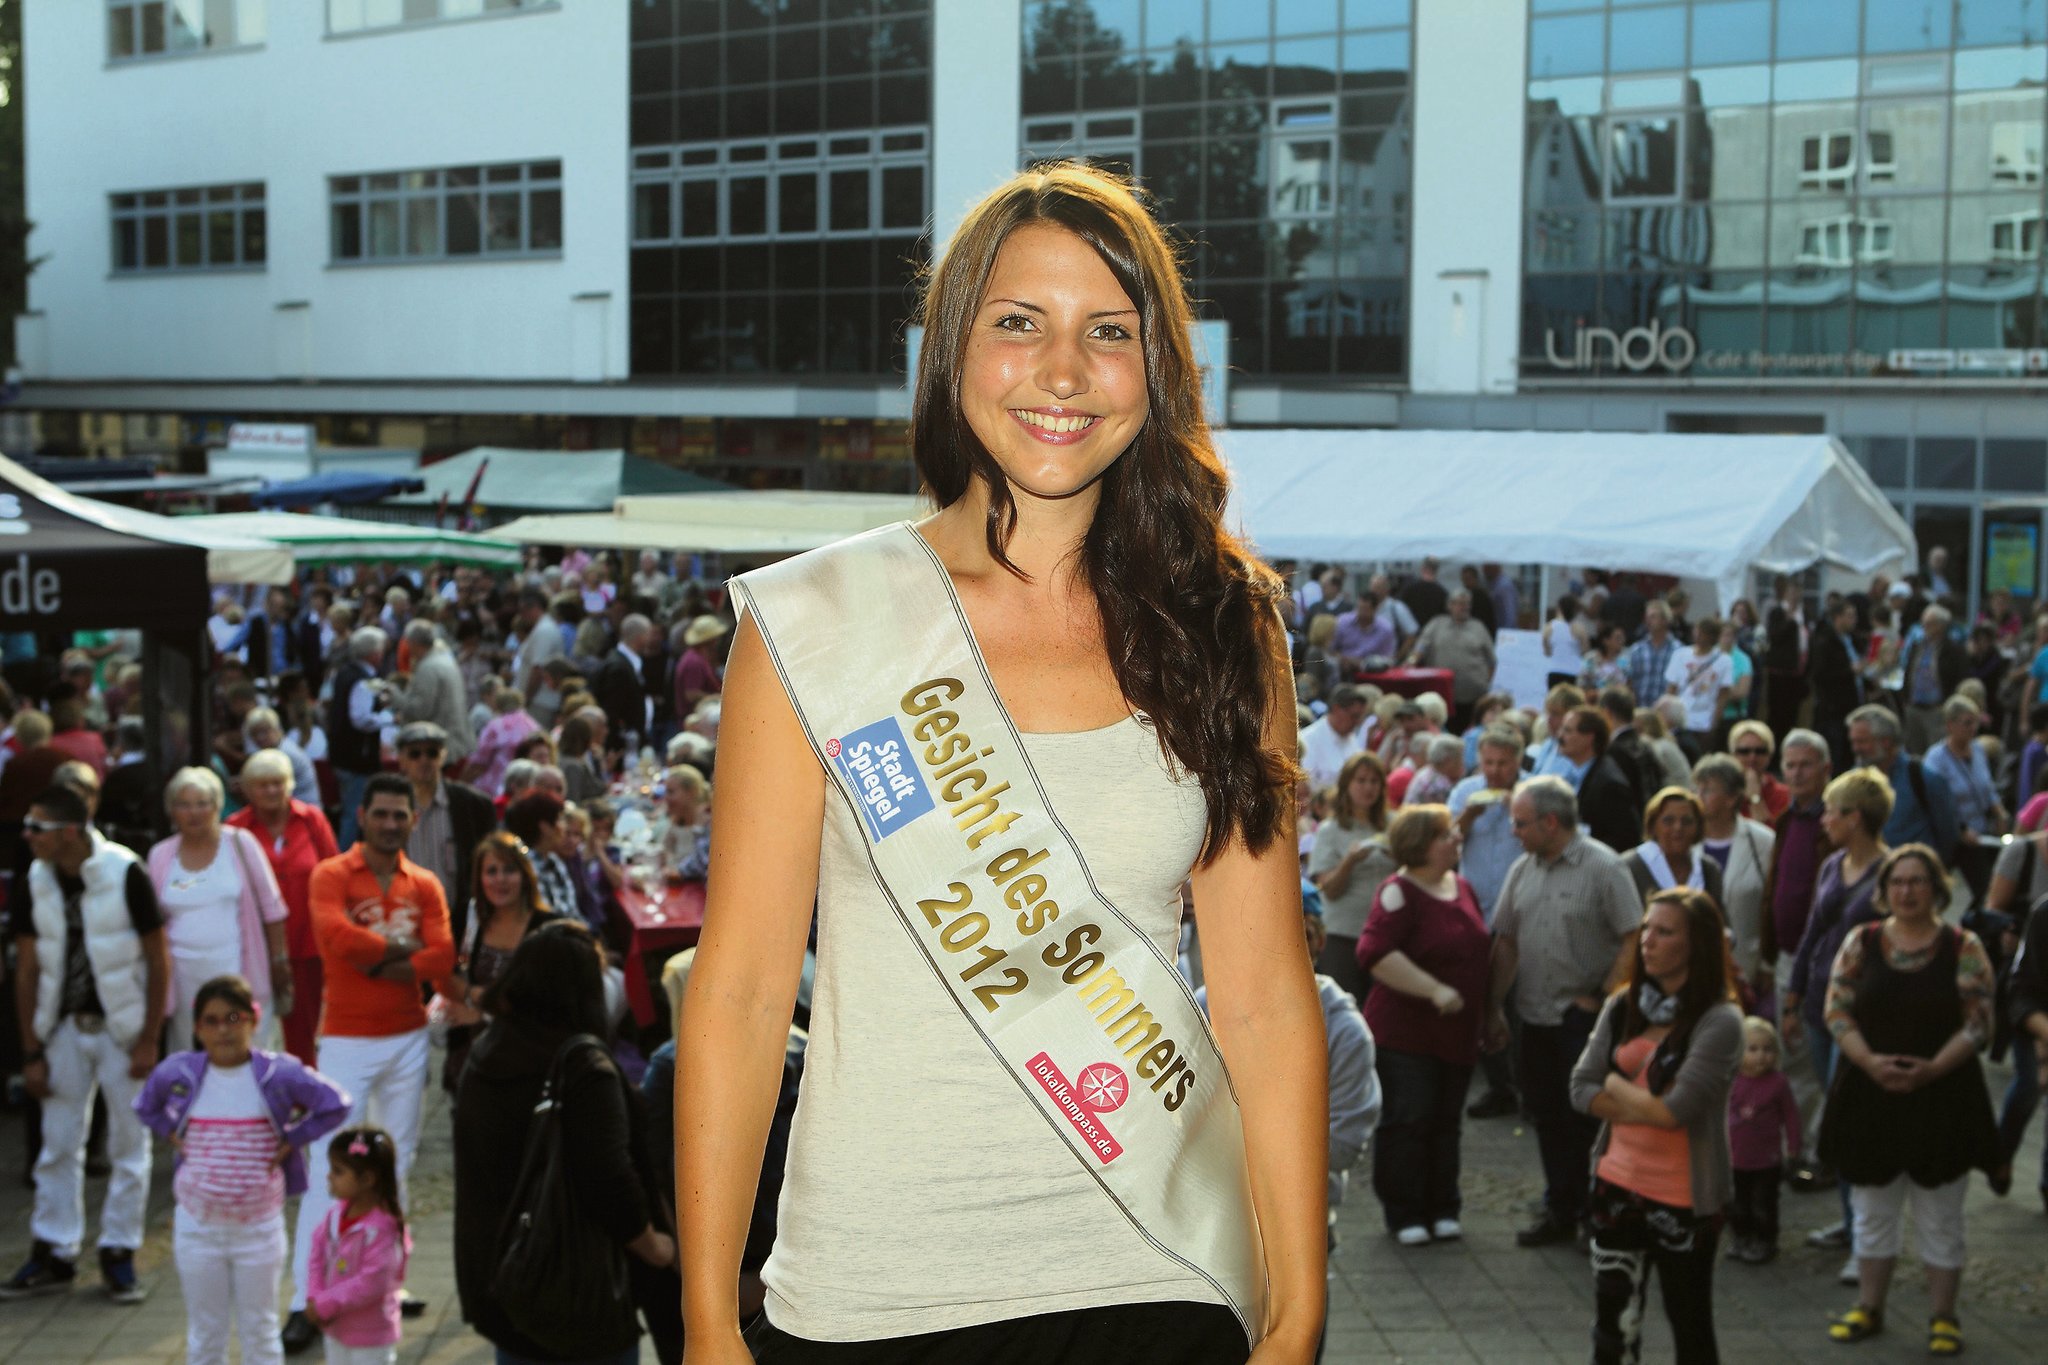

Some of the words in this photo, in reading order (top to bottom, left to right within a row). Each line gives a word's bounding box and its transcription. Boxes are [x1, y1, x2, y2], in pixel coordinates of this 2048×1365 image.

[848, 741, 902, 823] Spiegel
[874, 740, 916, 802] Stadt
[900, 677, 1023, 852] Gesicht
[985, 848, 1060, 937] des
[1041, 923, 1196, 1113] Sommers
[916, 881, 1030, 1014] 2012
[1034, 1059, 1113, 1156] lokalkompass.de
